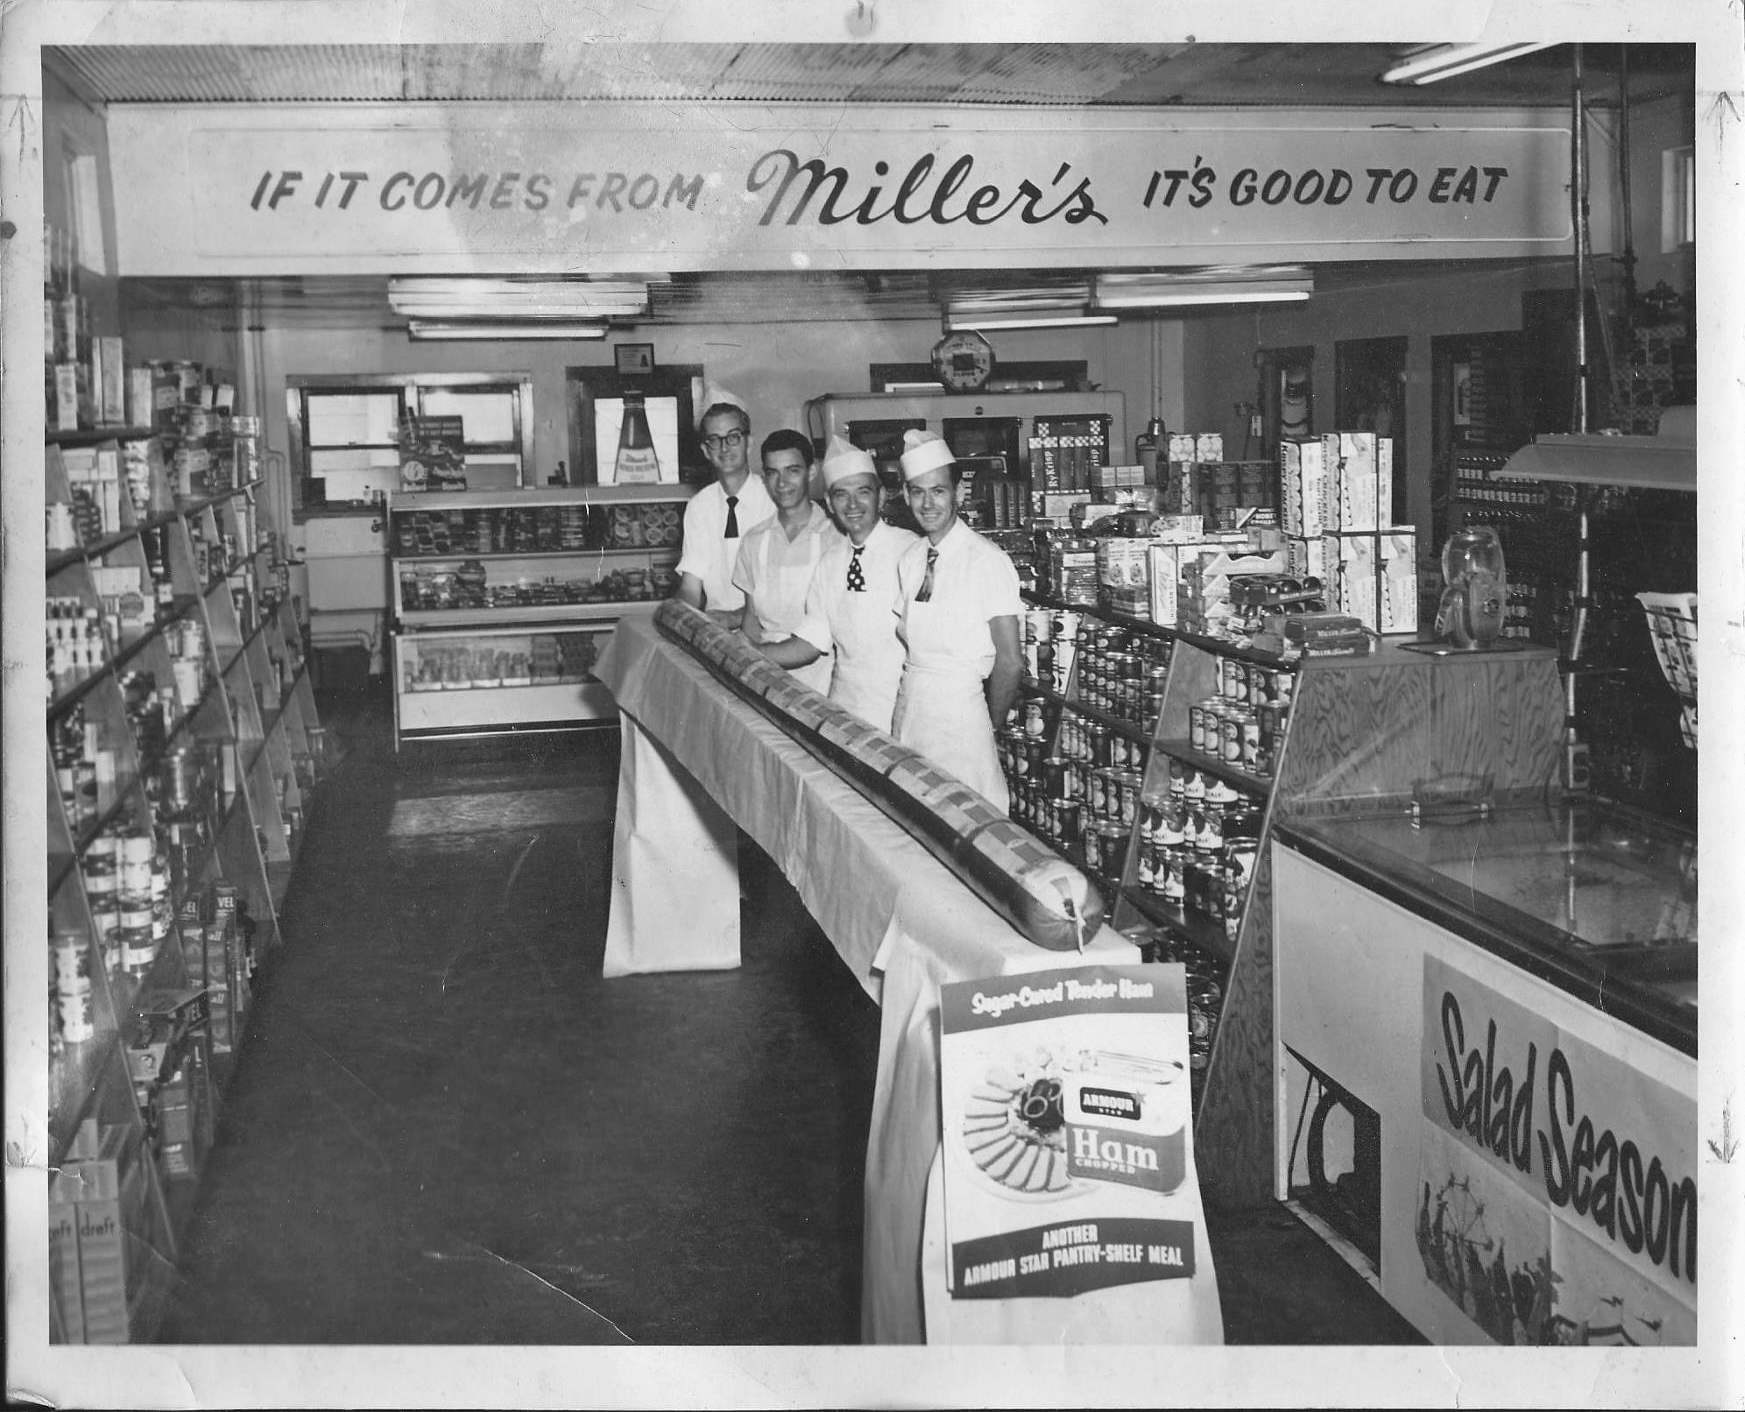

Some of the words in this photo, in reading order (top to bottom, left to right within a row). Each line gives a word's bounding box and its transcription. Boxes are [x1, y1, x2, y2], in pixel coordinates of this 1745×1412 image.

[249, 170, 303, 212] IF
[314, 171, 369, 211] IT
[379, 171, 552, 212] COMES
[566, 171, 705, 213] FROM
[746, 148, 1109, 226] Miller's
[1143, 154, 1217, 209] IT'S
[1229, 167, 1353, 207] GOOD
[1365, 168, 1418, 204] TO
[1428, 165, 1509, 204] EAT
[1044, 451, 1059, 487] RyKrisp
[1091, 449, 1100, 467] risp
[216, 897, 235, 908] VEL
[1119, 977, 1154, 1000] Ham
[1082, 1092, 1135, 1112] ARMOUR
[1072, 1127, 1160, 1171] Ham
[1436, 991, 1537, 1174] Salad
[1537, 1048, 1698, 1284] Season
[81, 1212, 116, 1238] dreft
[1042, 1223, 1099, 1250] ANOTHER
[963, 1258, 1017, 1287] ARMOUR
[1019, 1251, 1050, 1275] STAR
[1053, 1243, 1144, 1268] PANTRY-SHELF
